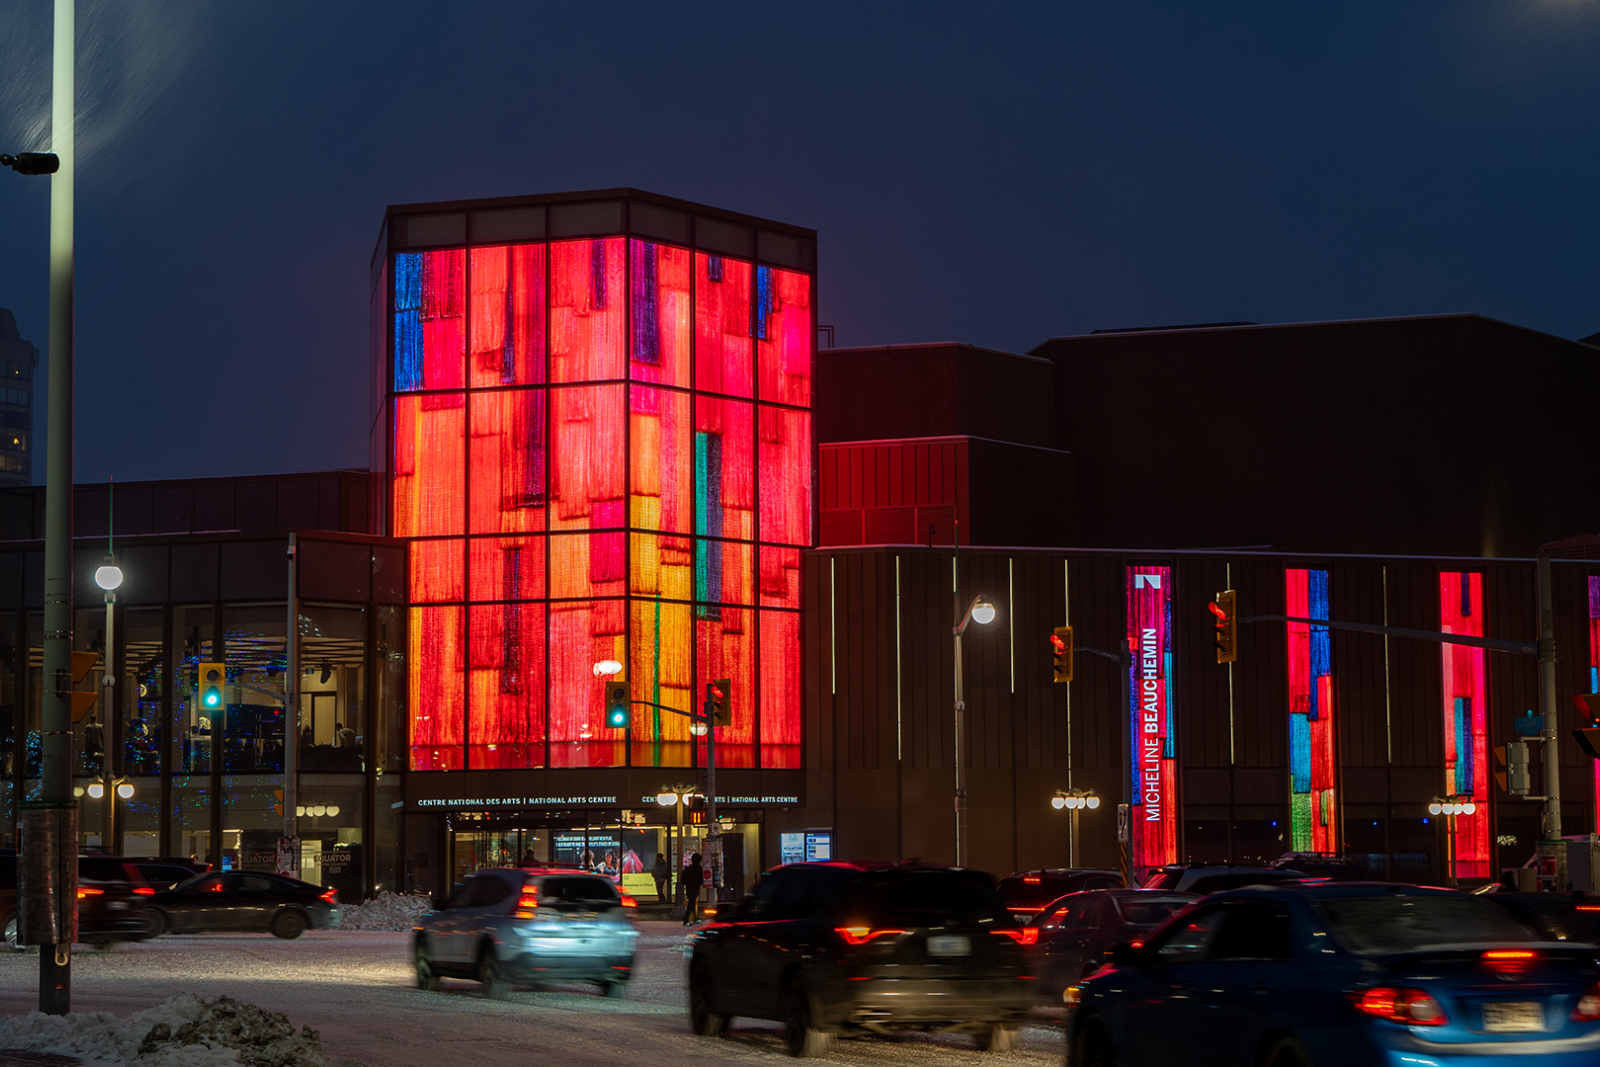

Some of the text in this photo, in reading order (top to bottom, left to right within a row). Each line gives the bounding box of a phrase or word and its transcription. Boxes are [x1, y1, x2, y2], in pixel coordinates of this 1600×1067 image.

[1143, 628, 1160, 821] MICHELINE BEAUCHEMIN
[237, 855, 275, 863] QUATOR
[313, 854, 352, 863] EQUATOR
